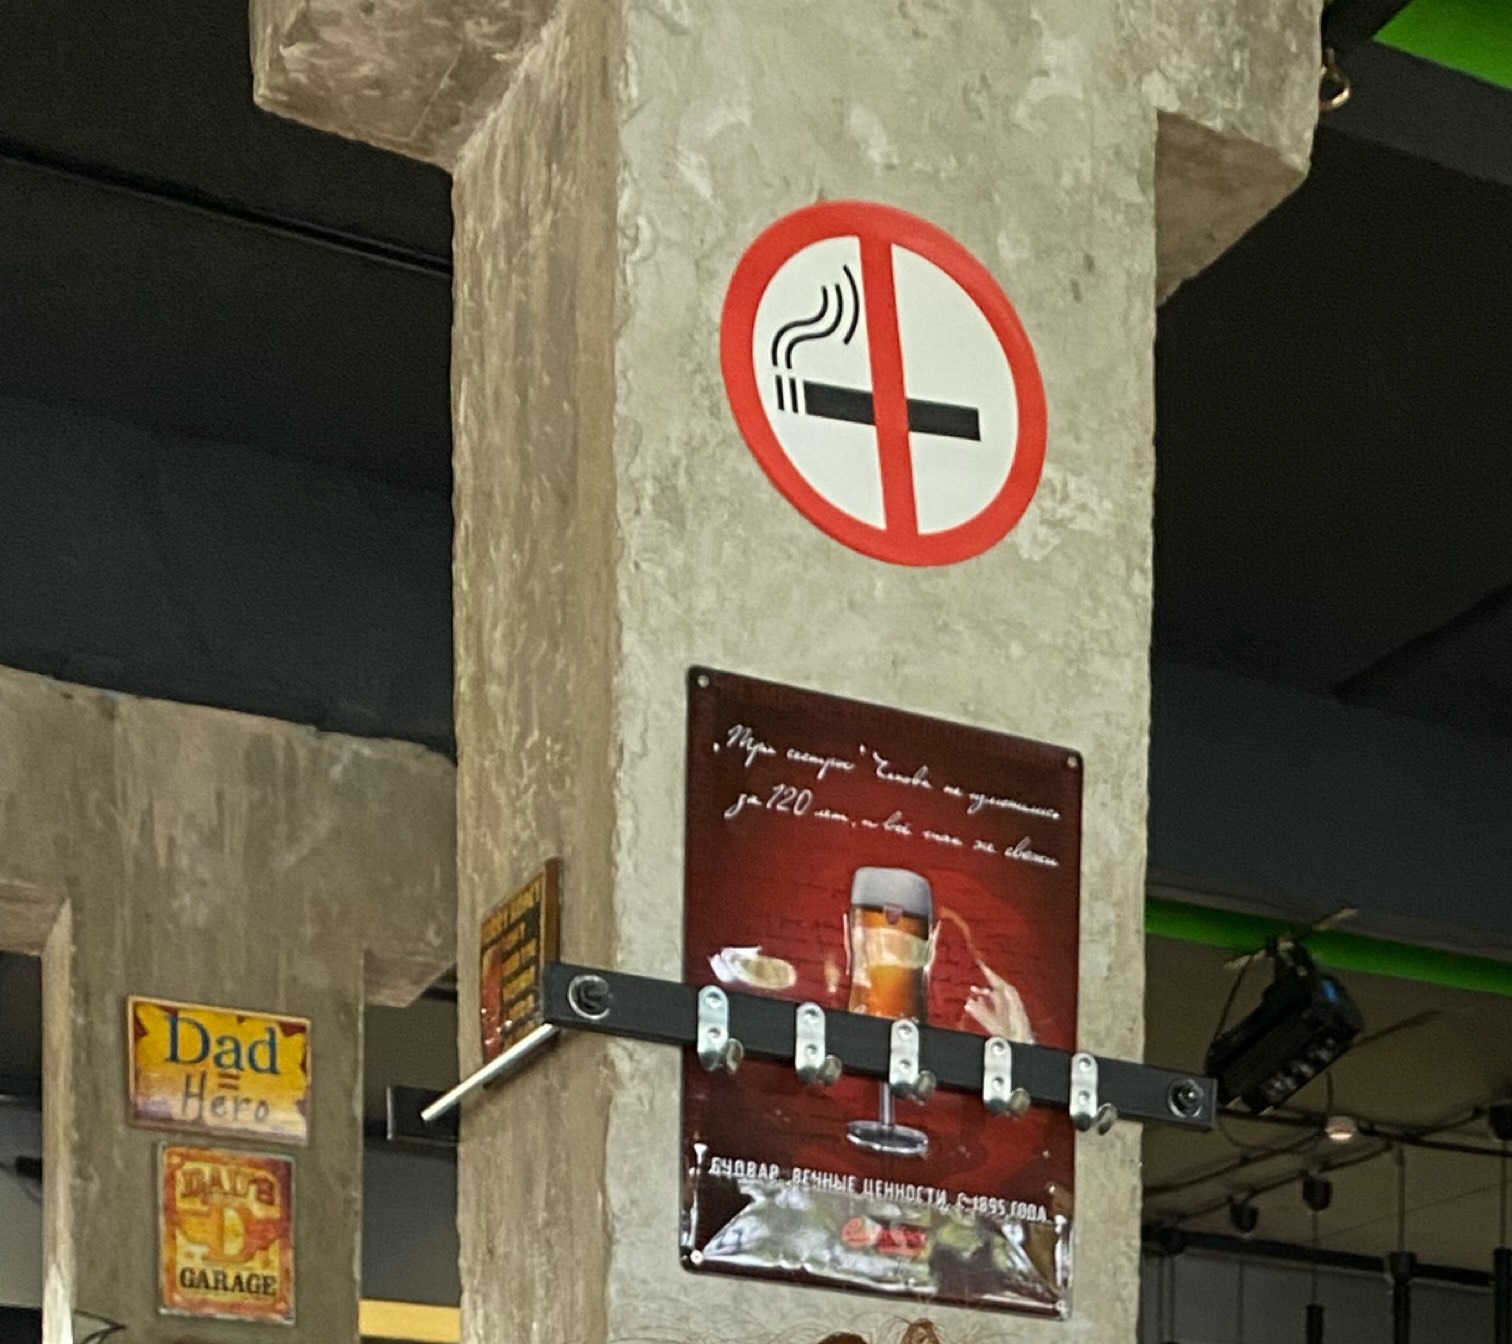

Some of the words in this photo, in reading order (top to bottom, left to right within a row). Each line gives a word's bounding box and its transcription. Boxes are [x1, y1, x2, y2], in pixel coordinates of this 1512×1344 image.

[765, 783, 815, 816] 120
[165, 1014, 281, 1076] Dad
[181, 1071, 270, 1123] Hero
[791, 1167, 857, 1194] ВЕЧНЫЕ
[180, 1267, 277, 1297] GARAGE
